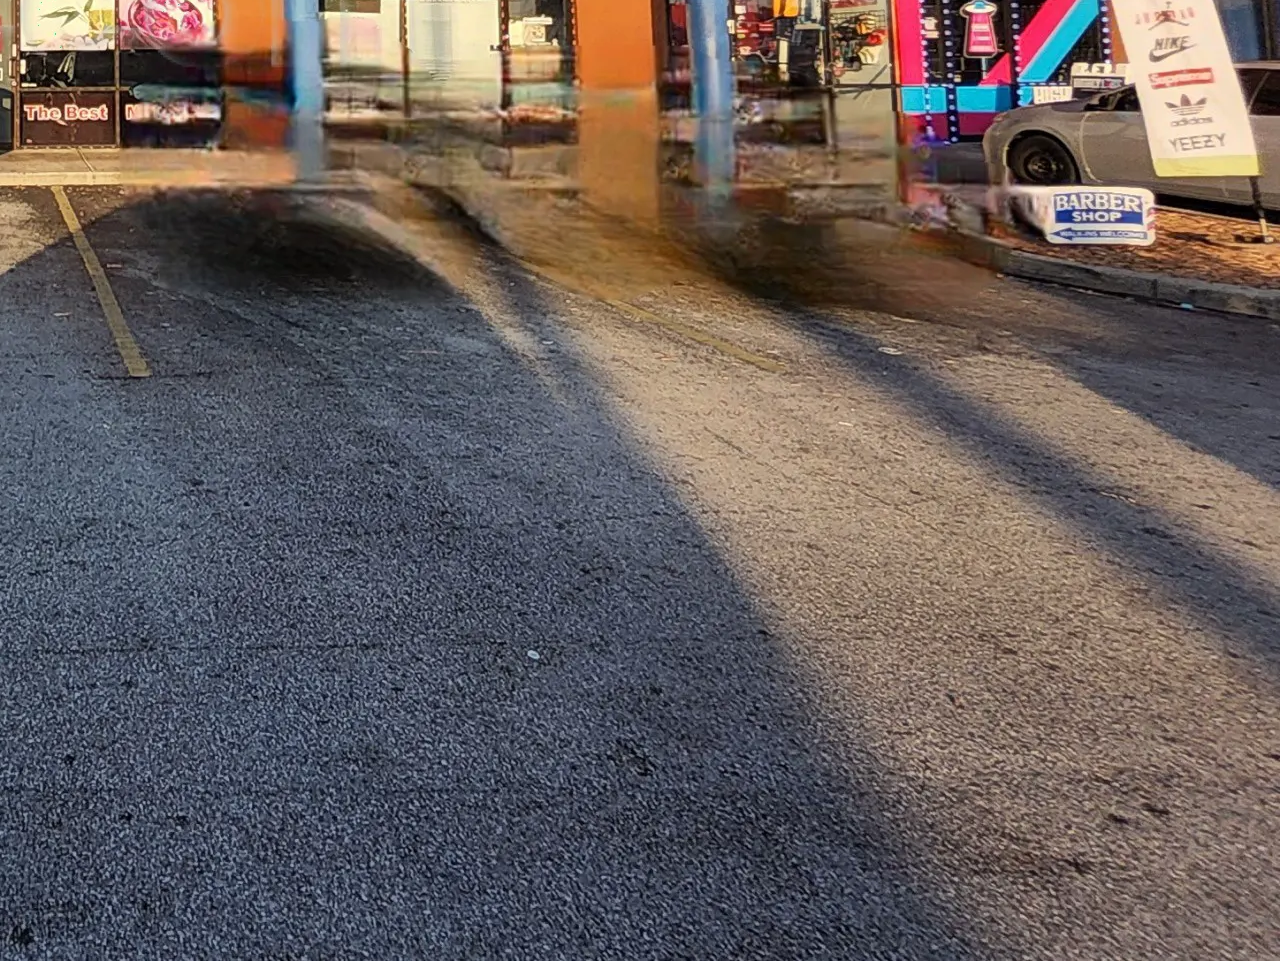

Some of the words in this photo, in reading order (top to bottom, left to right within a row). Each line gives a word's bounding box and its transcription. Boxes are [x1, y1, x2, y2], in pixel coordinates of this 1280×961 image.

[24, 104, 61, 121] The
[66, 104, 108, 121] Best
[1168, 133, 1226, 153] YEEZY
[1055, 192, 1143, 213] BARBER
[1071, 210, 1123, 223] SHOP
